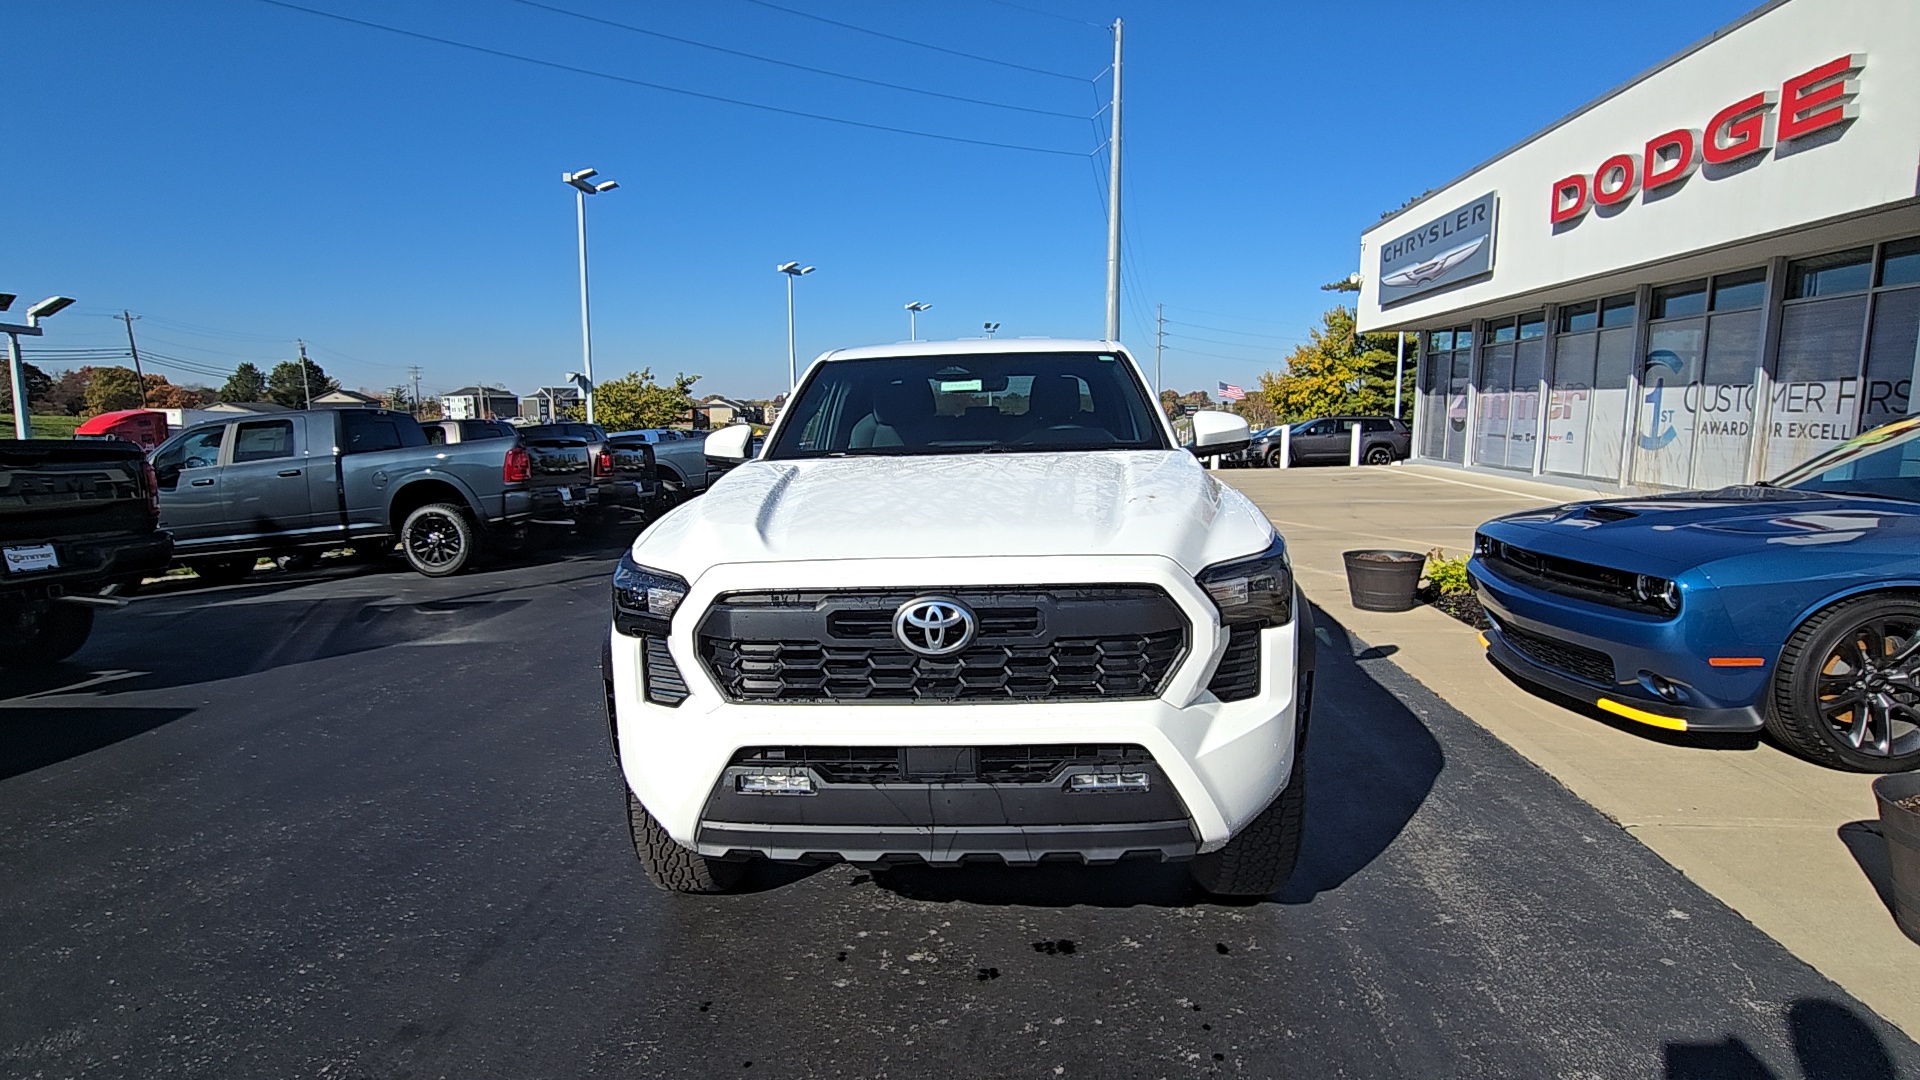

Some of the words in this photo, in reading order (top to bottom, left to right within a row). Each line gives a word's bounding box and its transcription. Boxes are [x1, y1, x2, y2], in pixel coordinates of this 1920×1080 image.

[1550, 53, 1862, 225] DODGE
[1383, 203, 1486, 263] CHRYSLER
[1700, 421, 1748, 436] AWARD
[2, 474, 98, 496] AM
